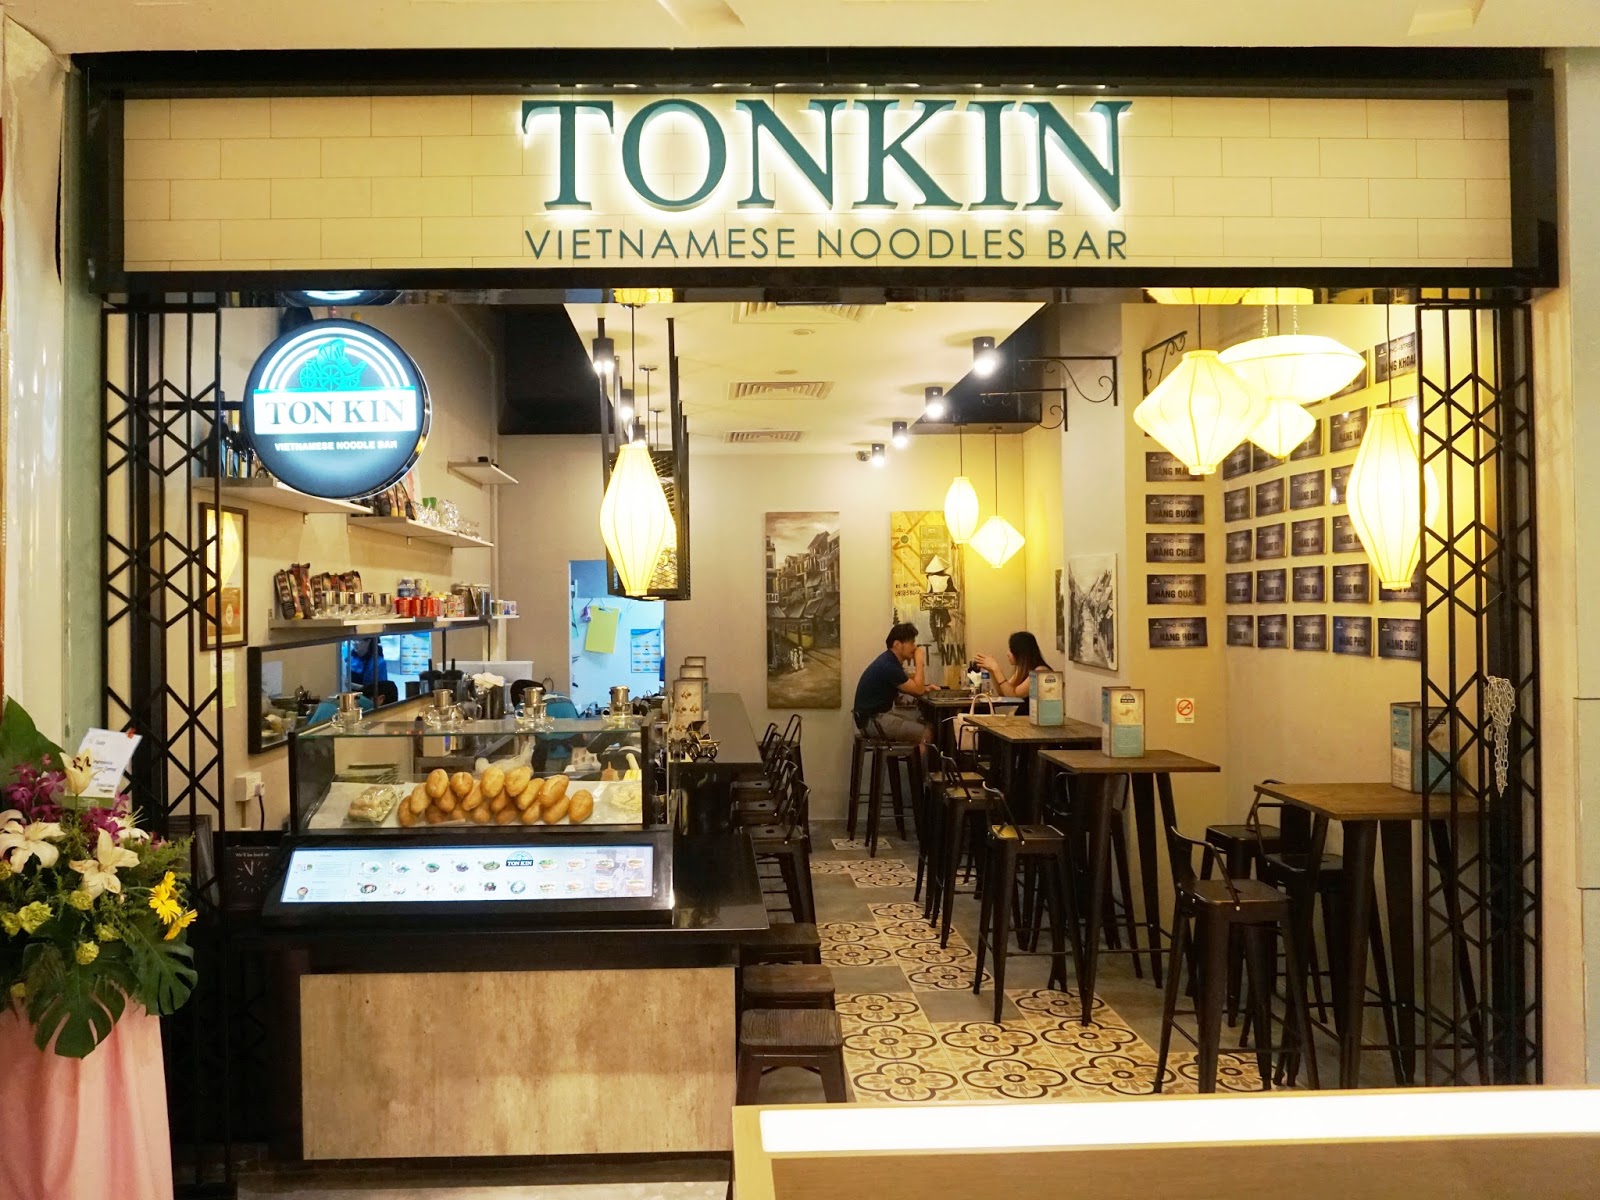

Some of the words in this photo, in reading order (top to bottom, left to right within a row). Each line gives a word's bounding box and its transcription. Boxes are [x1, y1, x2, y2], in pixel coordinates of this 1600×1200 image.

[521, 99, 1133, 212] TONKIN
[525, 228, 796, 260] VIETNAMESE
[817, 228, 1026, 260] NOODLES
[1047, 228, 1128, 260] BAR
[274, 441, 335, 452] VIETNAMESE
[336, 440, 376, 450] NOODLE
[377, 439, 398, 449] BAR
